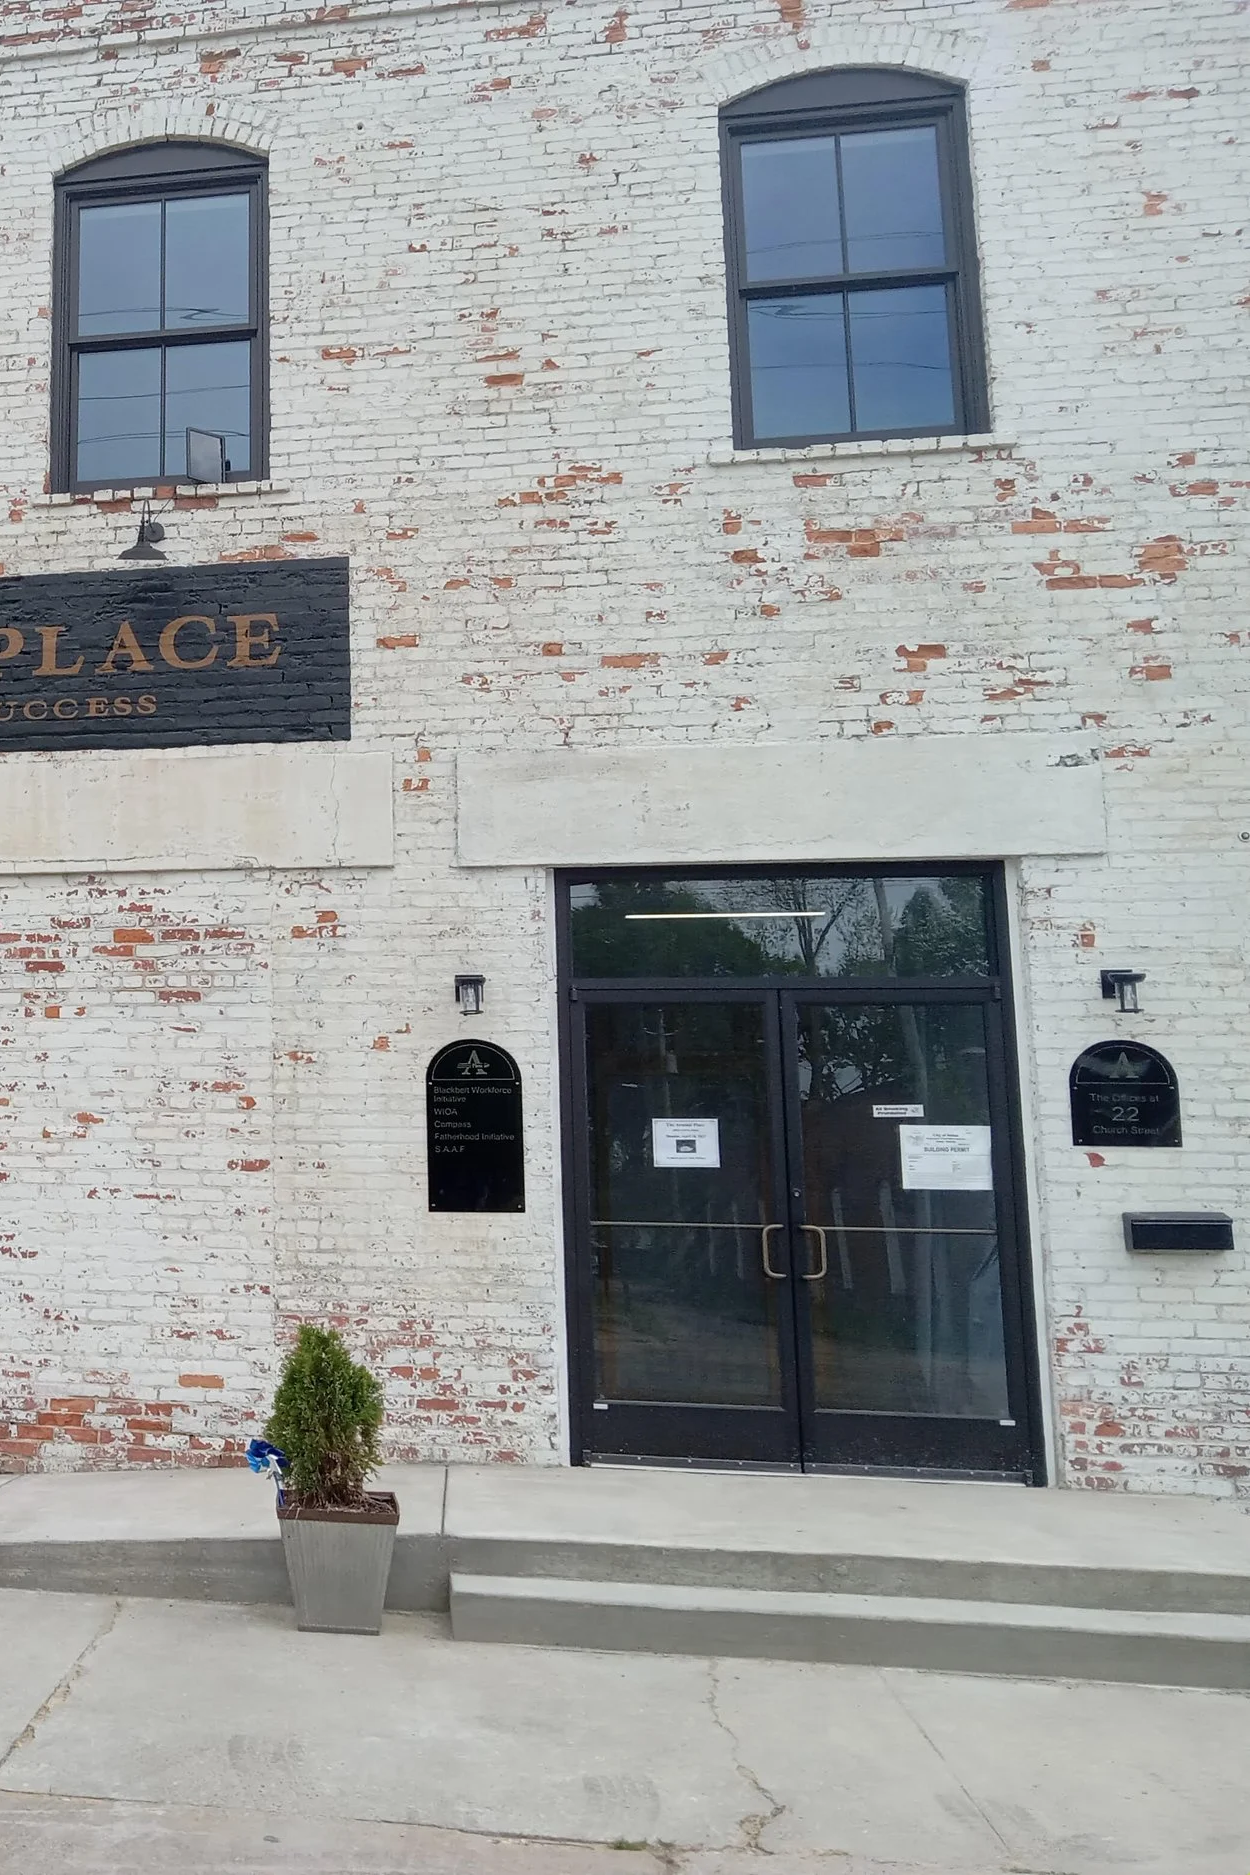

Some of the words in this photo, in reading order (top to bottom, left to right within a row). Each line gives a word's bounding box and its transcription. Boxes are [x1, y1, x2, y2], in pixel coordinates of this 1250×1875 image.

[471, 1086, 512, 1094] Workforce
[1089, 1093, 1109, 1102] The
[434, 1107, 458, 1116] WIOA
[1112, 1106, 1139, 1122] 22
[434, 1120, 471, 1129] Compass
[1092, 1125, 1128, 1134] Church
[1130, 1126, 1159, 1135] Street
[434, 1132, 480, 1141] Fatherhood
[481, 1133, 515, 1141] Initiative
